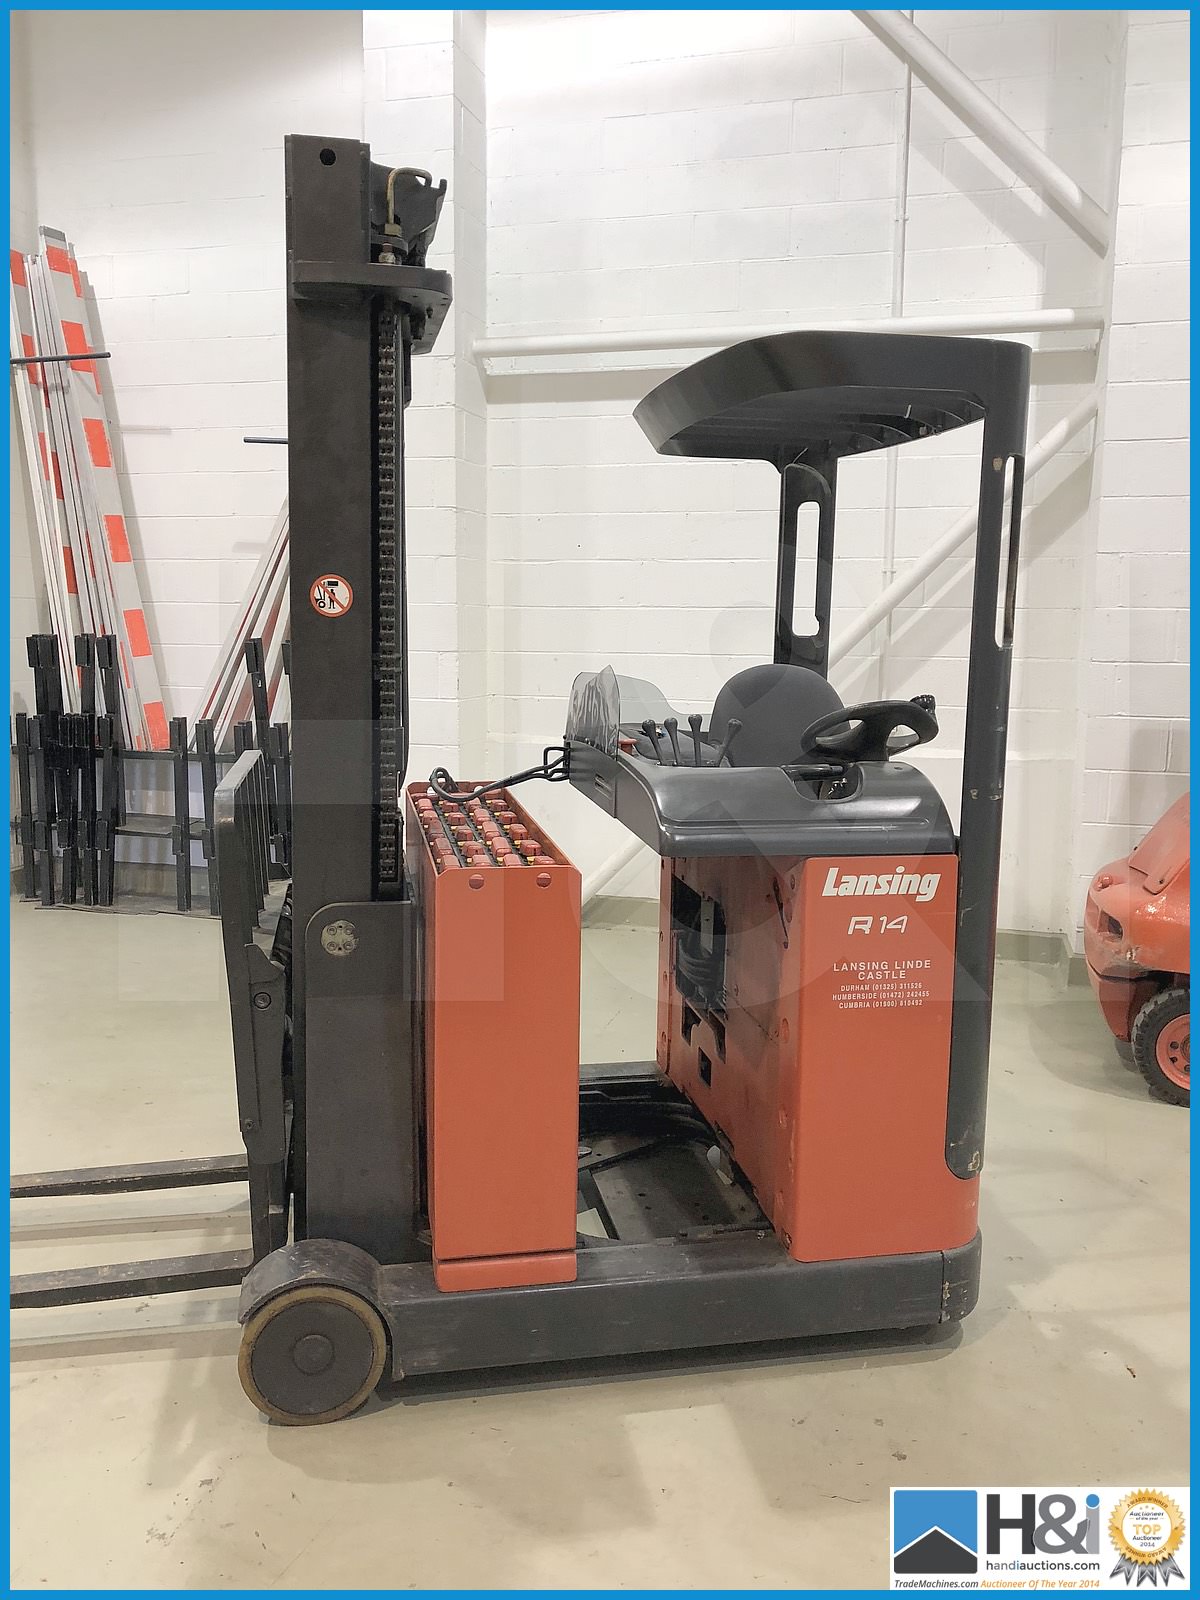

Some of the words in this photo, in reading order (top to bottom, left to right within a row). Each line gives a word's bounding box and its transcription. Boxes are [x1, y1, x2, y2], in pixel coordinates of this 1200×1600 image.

[821, 865, 942, 902] Lansing
[848, 915, 873, 935] R
[879, 915, 908, 935] 14
[833, 961, 889, 972] LANSING
[894, 959, 932, 969] LINDE
[858, 970, 907, 981] CASTLE
[840, 984, 870, 992] DURHAM
[872, 982, 897, 991] (01325)
[832, 992, 877, 1001] HUMBERSIDE
[879, 991, 905, 1000] (01472)
[838, 1001, 871, 1009] CUMBRIA
